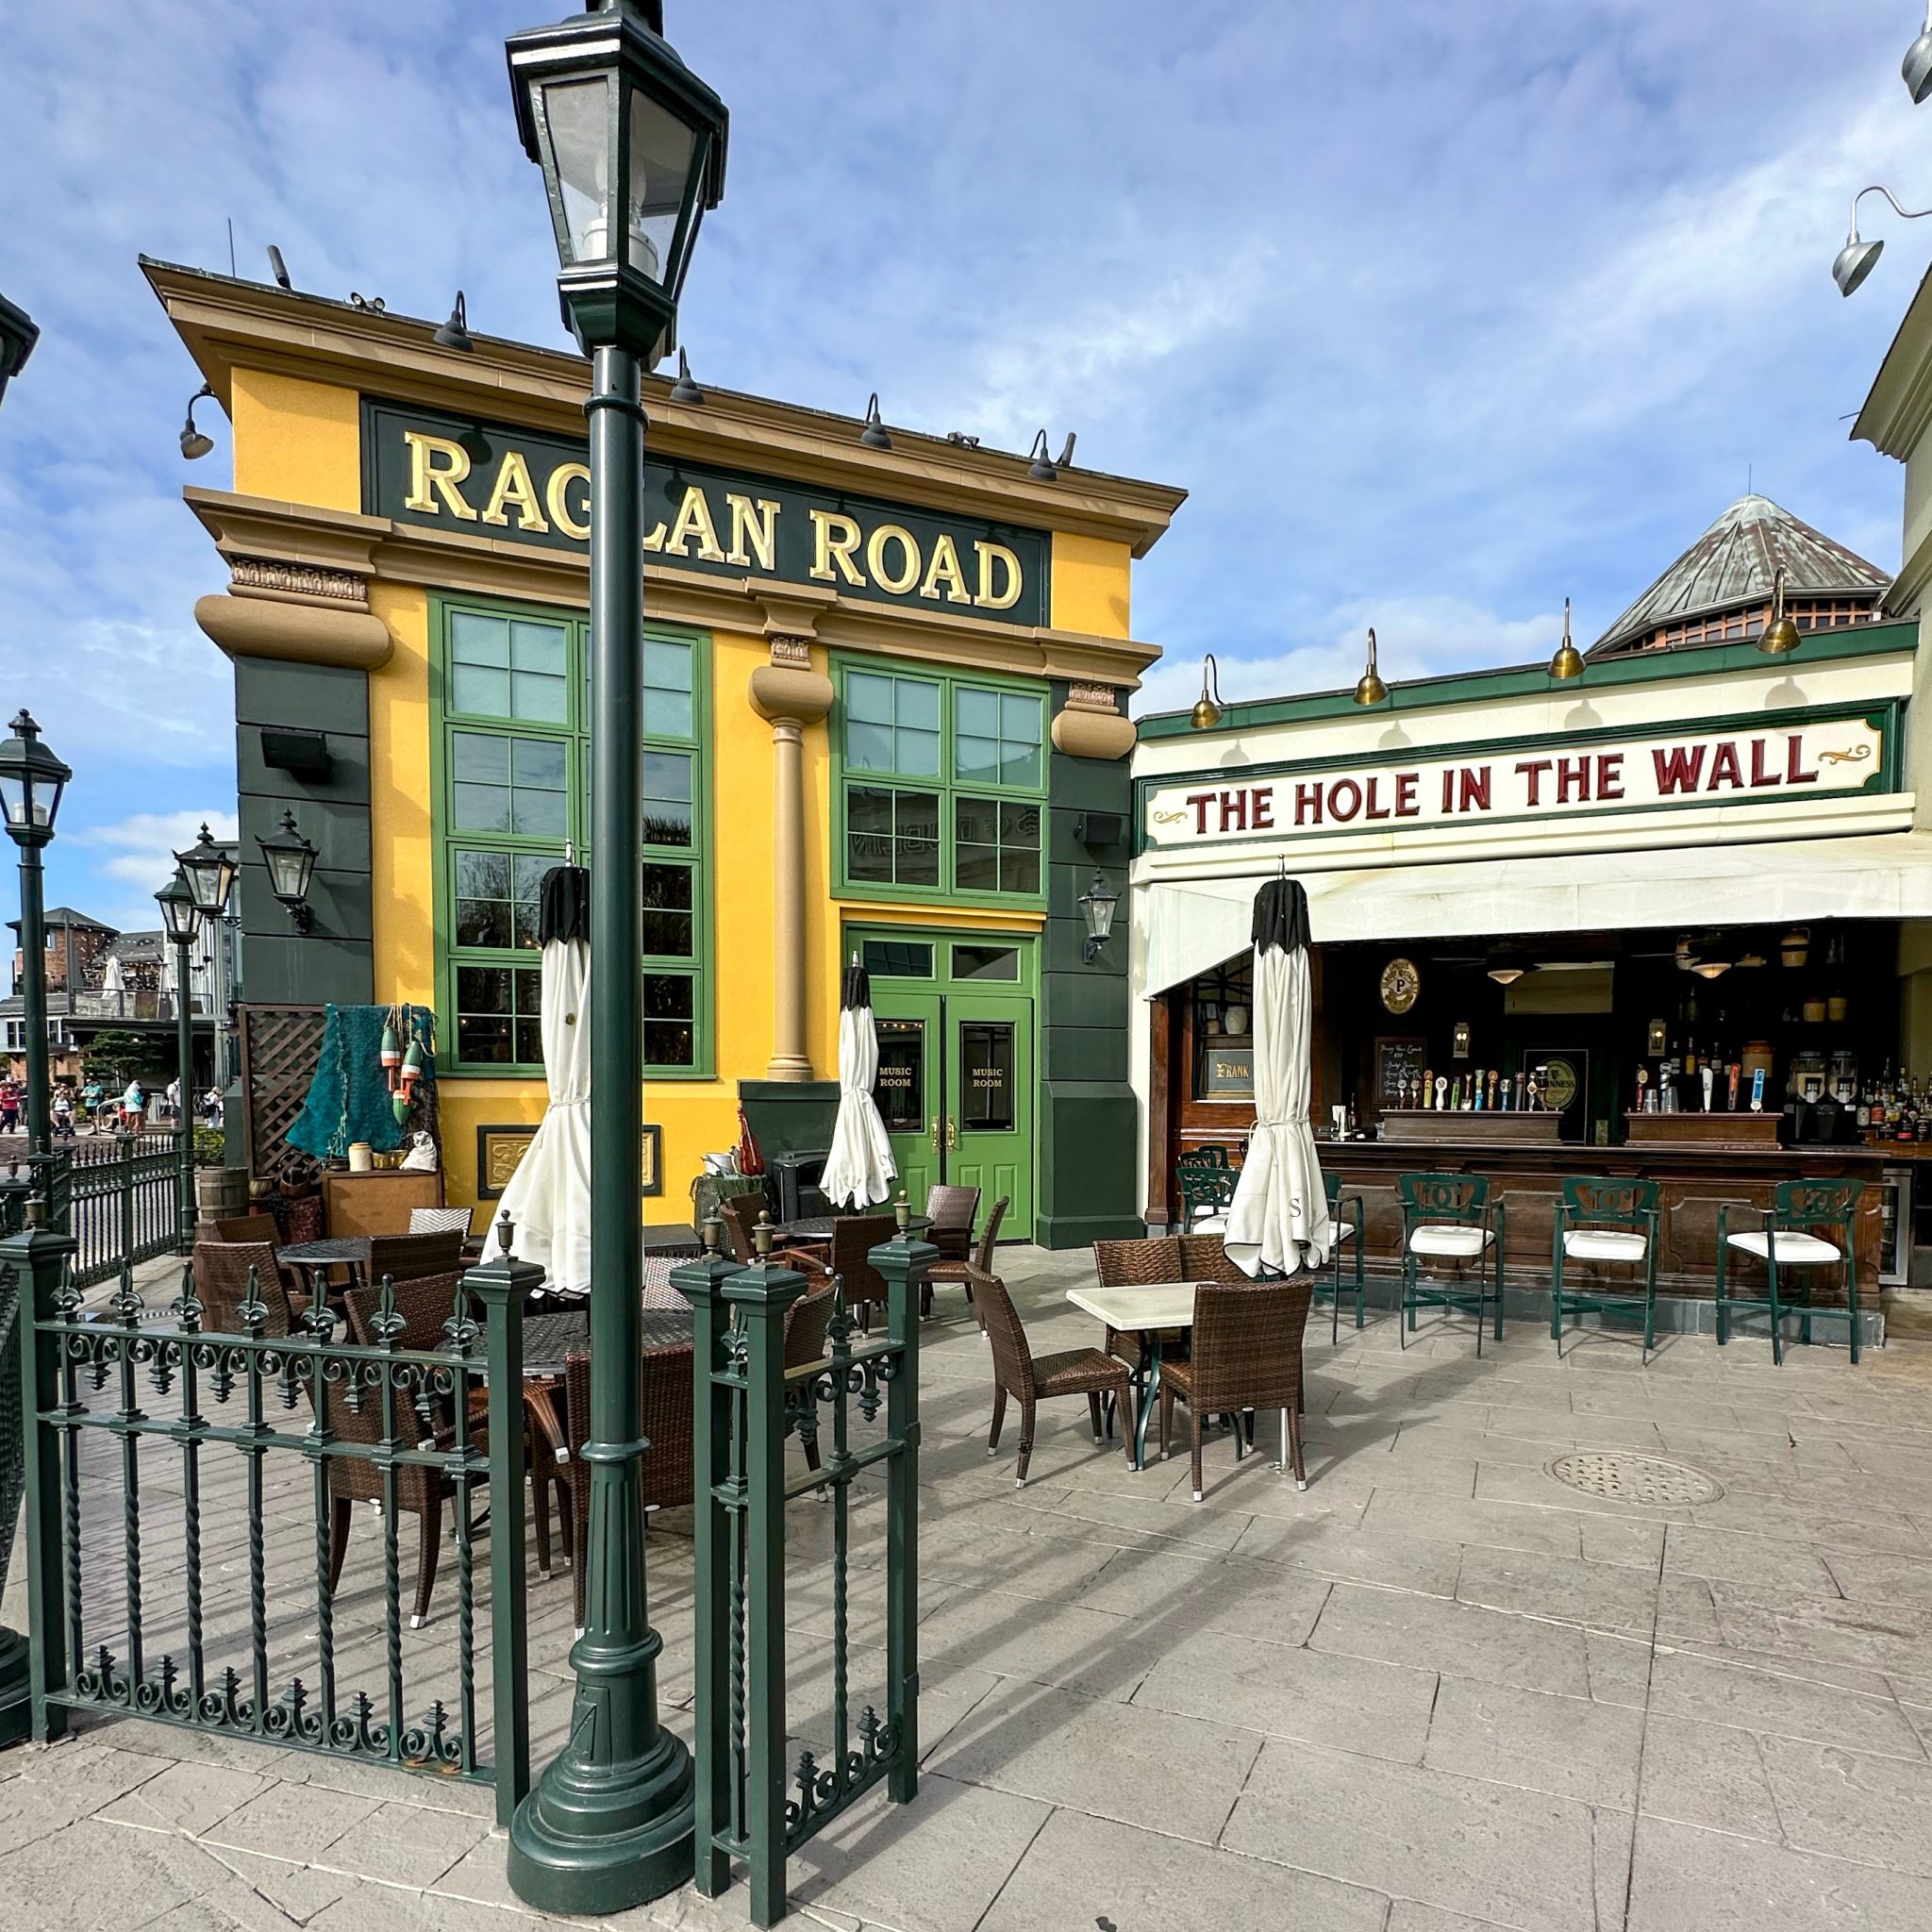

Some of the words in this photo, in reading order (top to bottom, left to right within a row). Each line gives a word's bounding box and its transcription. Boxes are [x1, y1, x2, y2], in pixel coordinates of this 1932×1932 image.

[809, 508, 1023, 609] ROAD
[1186, 787, 1274, 834] THE
[1294, 772, 1420, 826] HOLE
[1441, 766, 1491, 813] IN
[1514, 752, 1625, 807] THE
[1651, 735, 1820, 795] WALL
[1396, 979, 1406, 992] P
[879, 1067, 912, 1075] MUSIC
[972, 1068, 1004, 1076] MUSIC
[1216, 1063, 1250, 1078] FRANK
[879, 1078, 911, 1087] ROOM
[973, 1079, 1003, 1088] ROOM
